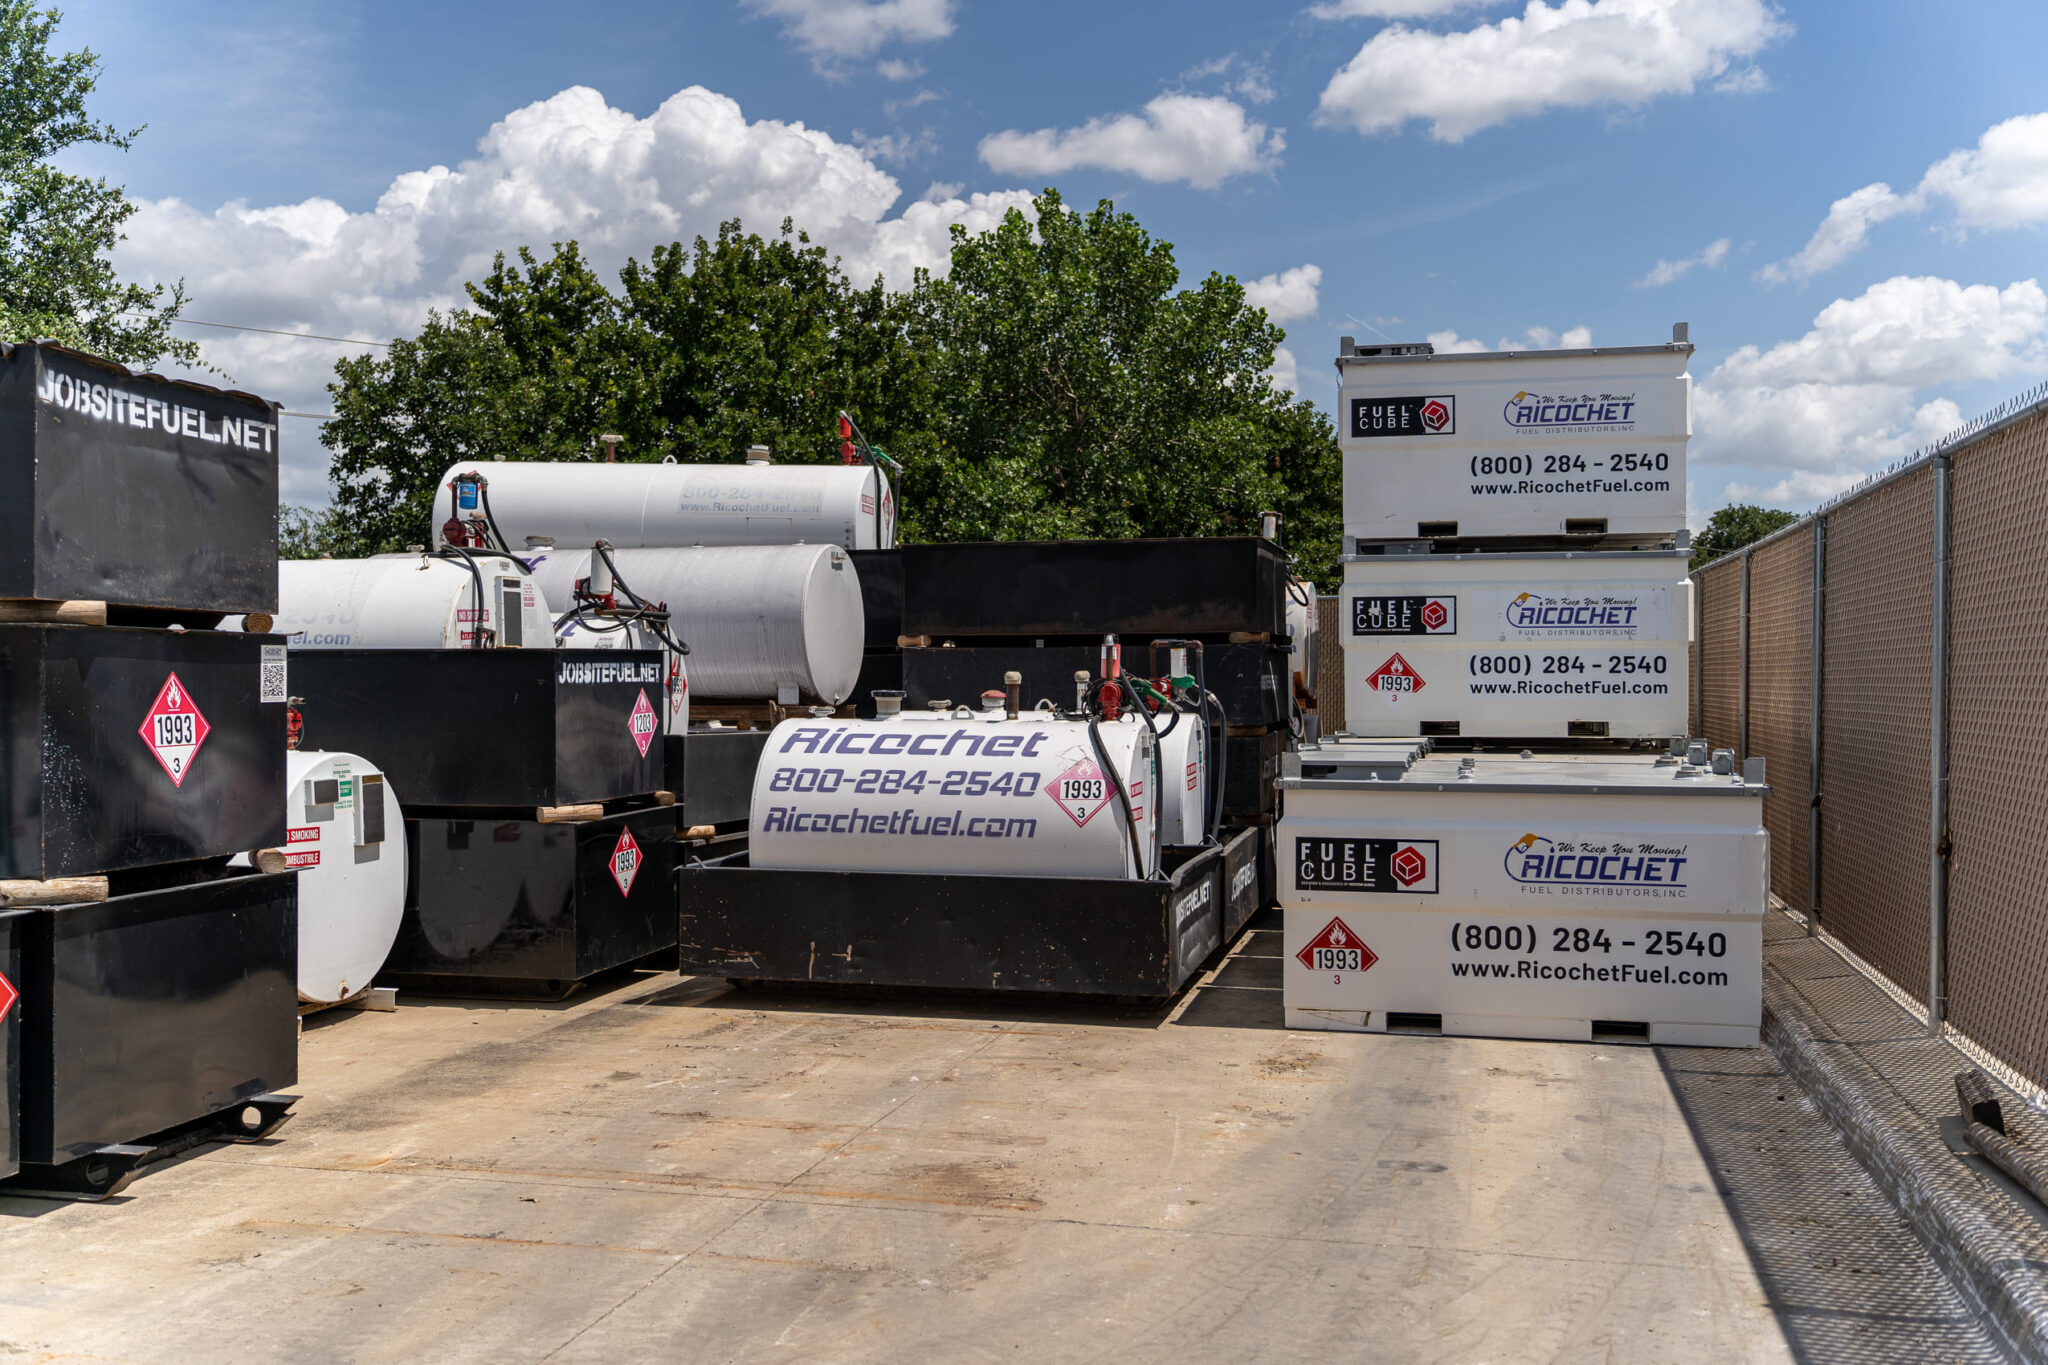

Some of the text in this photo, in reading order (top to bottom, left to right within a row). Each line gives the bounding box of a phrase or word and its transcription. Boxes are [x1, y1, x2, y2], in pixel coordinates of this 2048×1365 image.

[37, 369, 276, 453] JOBSITEFUEL.NET
[1359, 405, 1410, 418] FUEL
[1359, 416, 1410, 429] CUBE
[1471, 454, 1532, 477] (800)
[1544, 454, 1587, 473] 284
[1610, 453, 1669, 472] 2540
[1471, 479, 1670, 495] www.RicochetFuel.com
[1356, 600, 1411, 614] FUEL
[1356, 614, 1411, 628] CUBE
[559, 662, 661, 684] JOBSITEFUEL.NET
[1470, 655, 1531, 676] (800)
[1542, 656, 1586, 674] 284
[1609, 655, 1668, 674] 2540
[1379, 675, 1412, 692] 1993
[1470, 680, 1669, 694] www.RicochetFuel.com
[1391, 694, 1398, 702] 3
[157, 714, 193, 745] 1993
[635, 713, 652, 733] 1203
[640, 740, 646, 751] 3
[779, 727, 1048, 757] Ricochet
[173, 757, 181, 774] 3
[769, 768, 1041, 797] 800-284-2540
[1063, 780, 1102, 799] 1993
[1077, 807, 1086, 819] 3
[763, 807, 1037, 838] Ricochetfuel.com
[291, 829, 319, 841] SMOKING
[1301, 843, 1375, 863] FUEL
[1557, 842, 1687, 857] We Keep You Moving!
[285, 852, 319, 865] OMBUSTIBLE
[617, 850, 635, 872] 1993
[1301, 861, 1376, 882] CUBE
[623, 878, 629, 889] 3
[1521, 886, 1552, 894] FUEL
[1451, 923, 1537, 954] (800)
[1552, 927, 1612, 954] 284
[1645, 930, 1727, 958] 2540
[1316, 949, 1359, 970] 1993
[1333, 974, 1341, 985] 3
[1451, 960, 1728, 986] www.RicochetFuel.com
